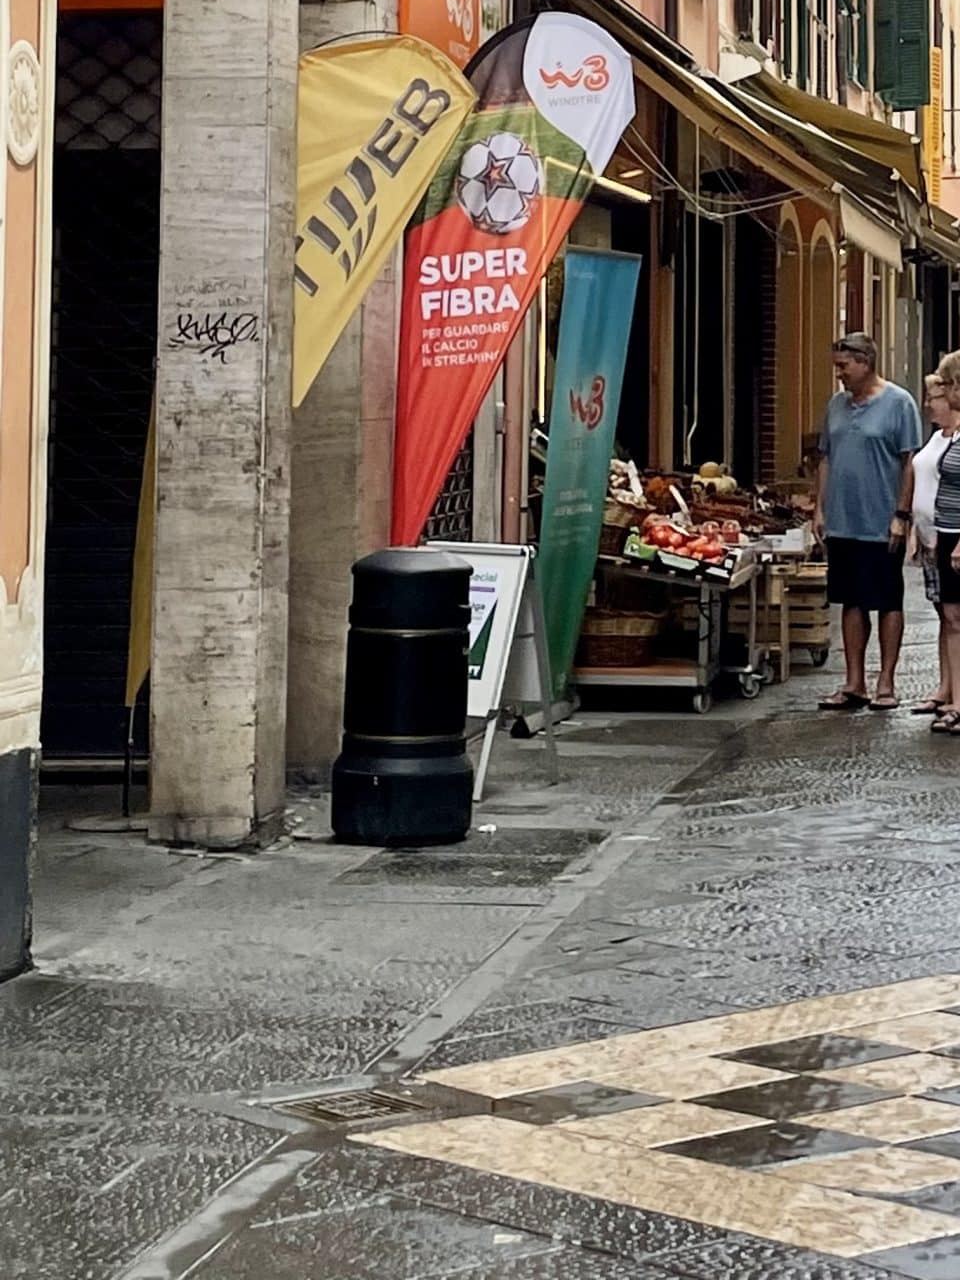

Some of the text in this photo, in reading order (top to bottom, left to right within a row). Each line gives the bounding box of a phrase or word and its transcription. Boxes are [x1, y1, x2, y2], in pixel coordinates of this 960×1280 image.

[548, 94, 602, 108] WINDTRE
[418, 247, 529, 286] SUPER
[420, 283, 521, 321] FIBRA
[422, 322, 509, 340] PER GUARDARE
[421, 339, 477, 355] IL CALCIO
